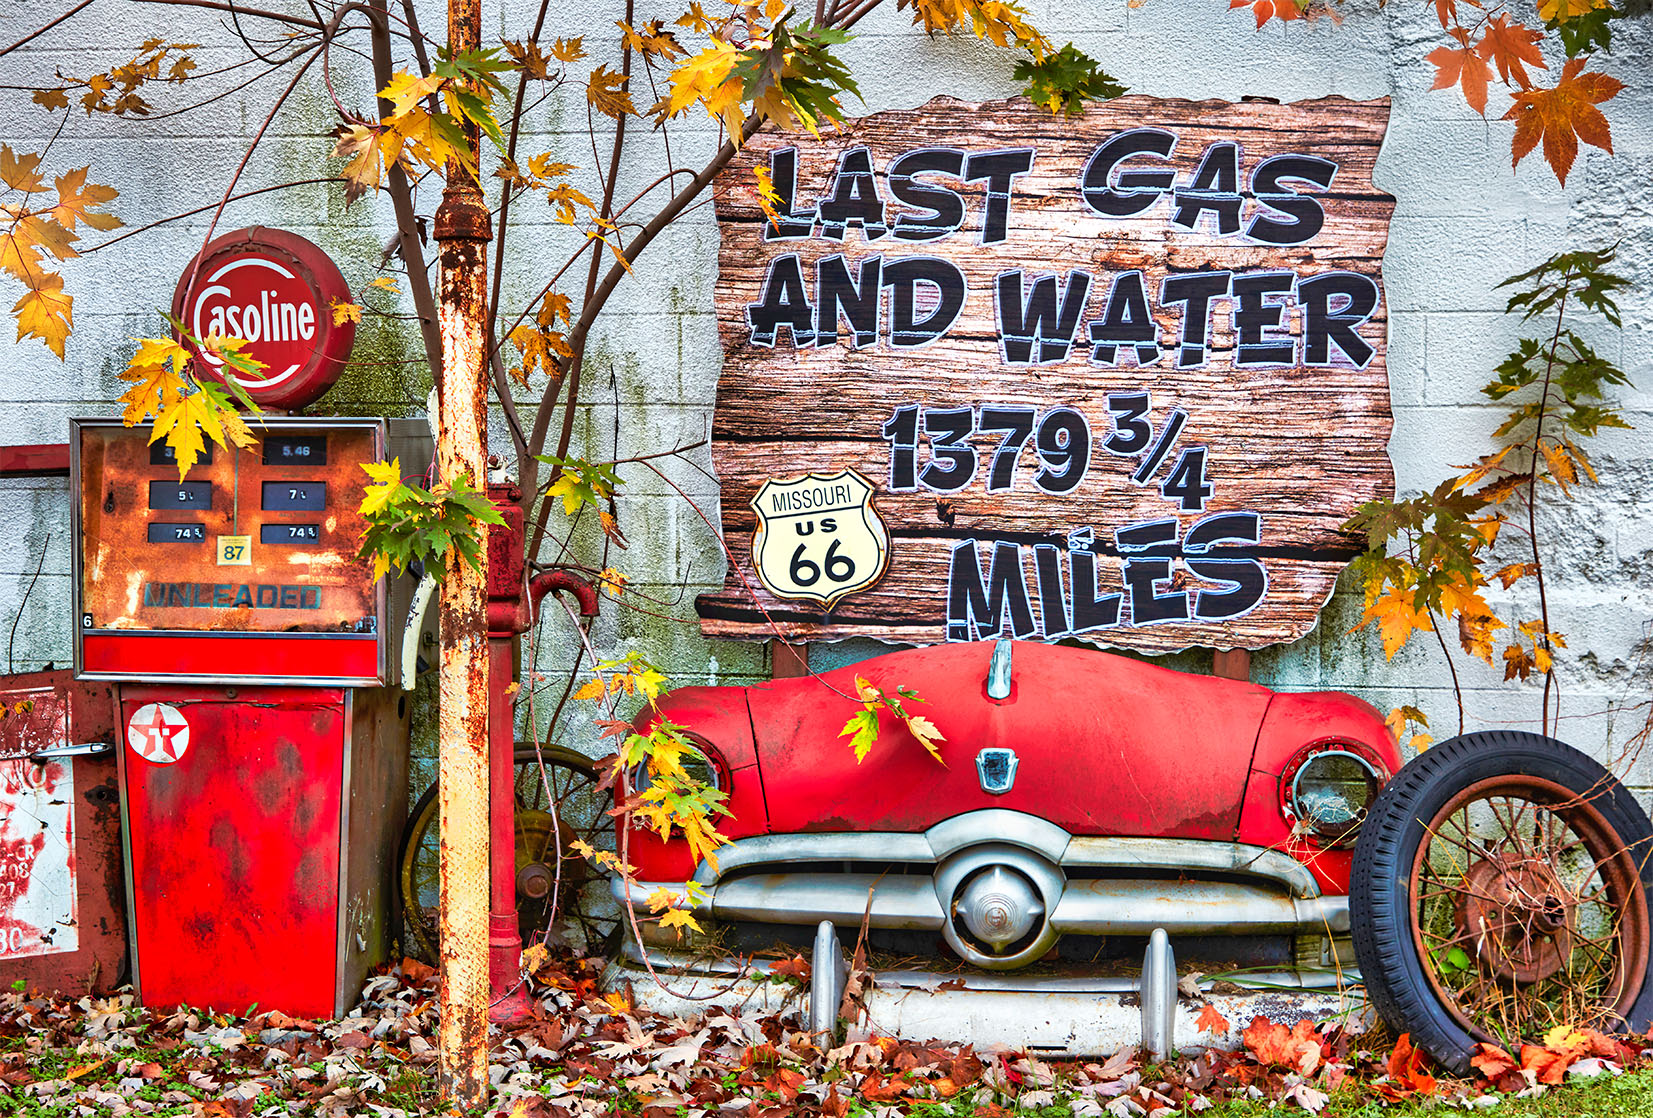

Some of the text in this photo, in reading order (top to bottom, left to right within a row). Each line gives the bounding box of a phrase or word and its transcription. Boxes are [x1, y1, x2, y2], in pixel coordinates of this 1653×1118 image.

[764, 127, 1339, 246] LAST GAS
[193, 285, 315, 366] Gasoline
[745, 253, 1381, 370] AND WATER
[282, 446, 311, 456] 5.46
[882, 404, 1094, 495] 1379
[772, 484, 852, 512] MISSOURI
[224, 545, 245, 560] 87
[789, 538, 856, 587] 66
[946, 511, 1270, 642] MILES
[143, 583, 322, 609] UNLEADED
[83, 615, 92, 627] 6
